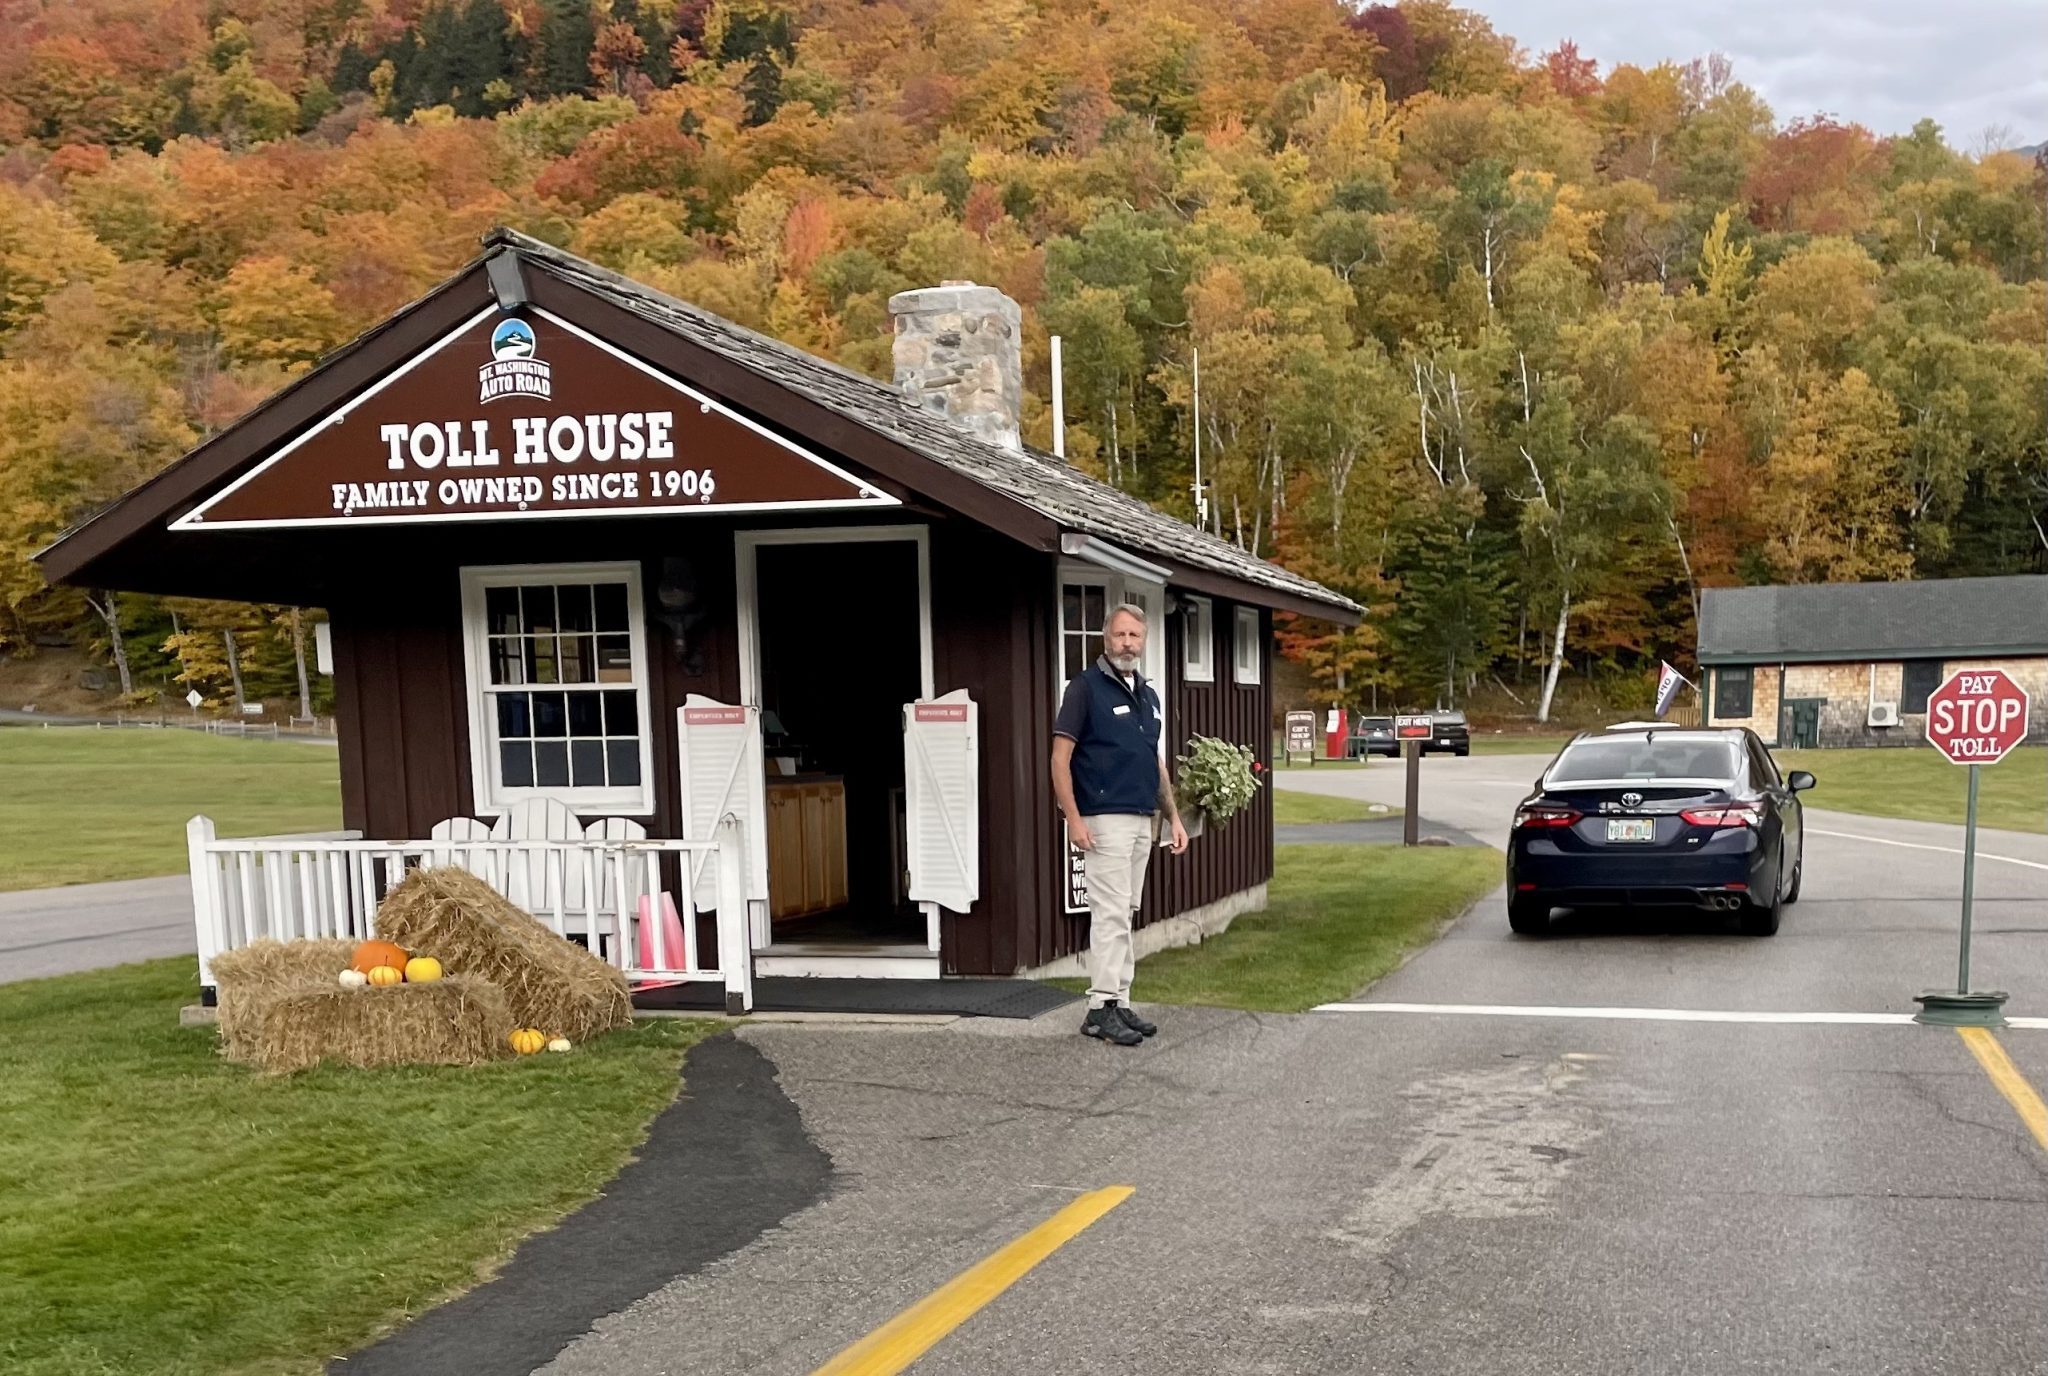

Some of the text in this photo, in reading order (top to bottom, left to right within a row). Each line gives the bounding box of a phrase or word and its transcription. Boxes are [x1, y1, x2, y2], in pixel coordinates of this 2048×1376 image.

[494, 360, 551, 379] WASHINGTON
[480, 373, 551, 401] AUTO ROAD
[380, 411, 674, 470] TOLL HOUSE
[331, 469, 716, 509] FAMILY OWNED SINCE 1906
[1959, 675, 1998, 695] PAY
[1934, 698, 2022, 734] STOP
[1949, 737, 2002, 757] TOLL
